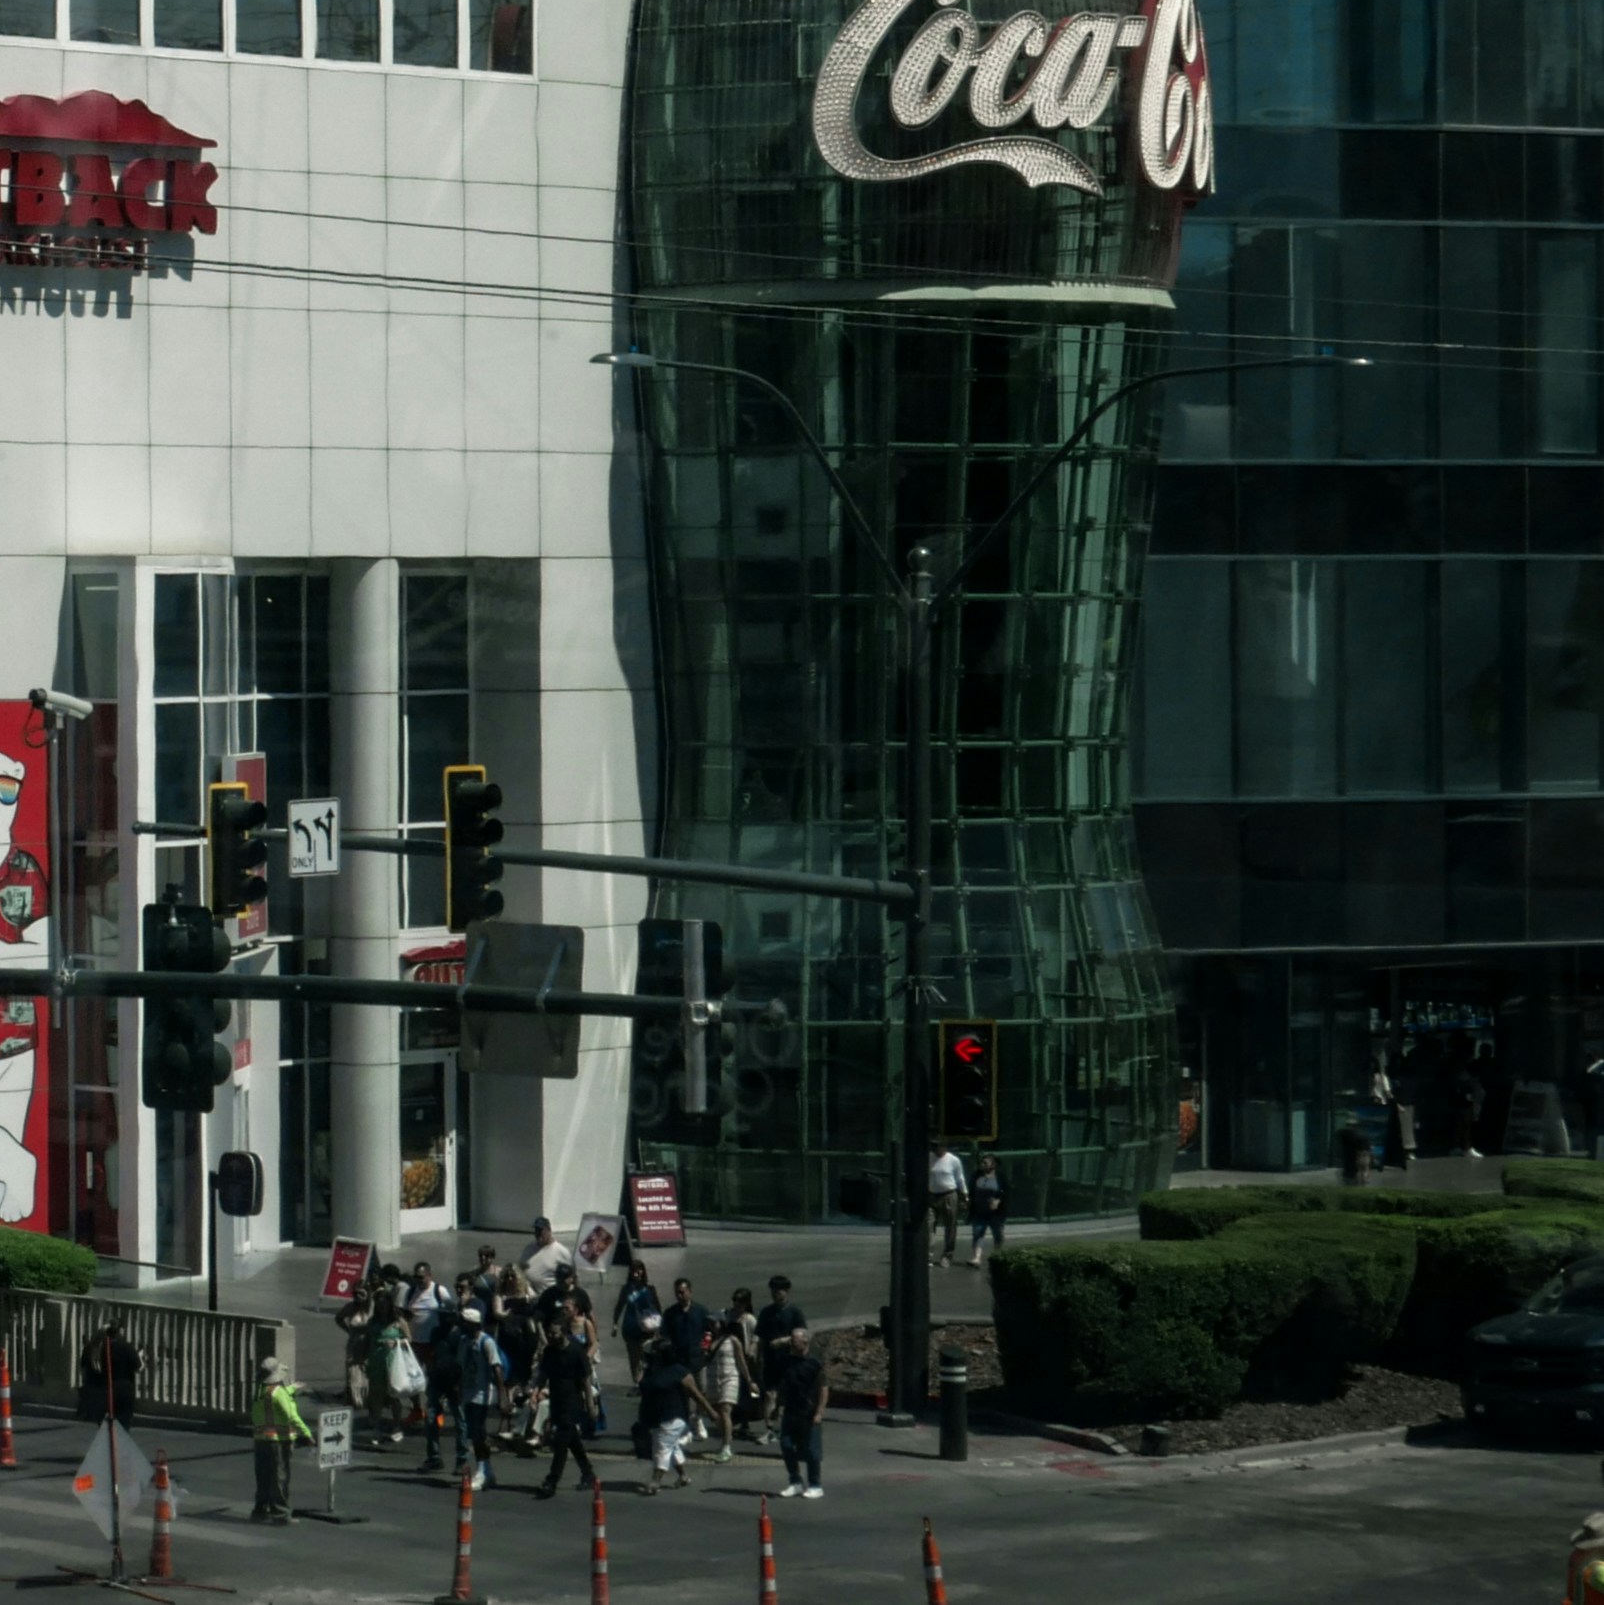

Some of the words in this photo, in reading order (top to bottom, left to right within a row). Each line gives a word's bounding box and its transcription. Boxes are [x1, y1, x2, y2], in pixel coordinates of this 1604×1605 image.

[292, 857, 313, 869] ONLY
[323, 1412, 348, 1427] KEEP
[320, 1451, 349, 1465] RIGHT
